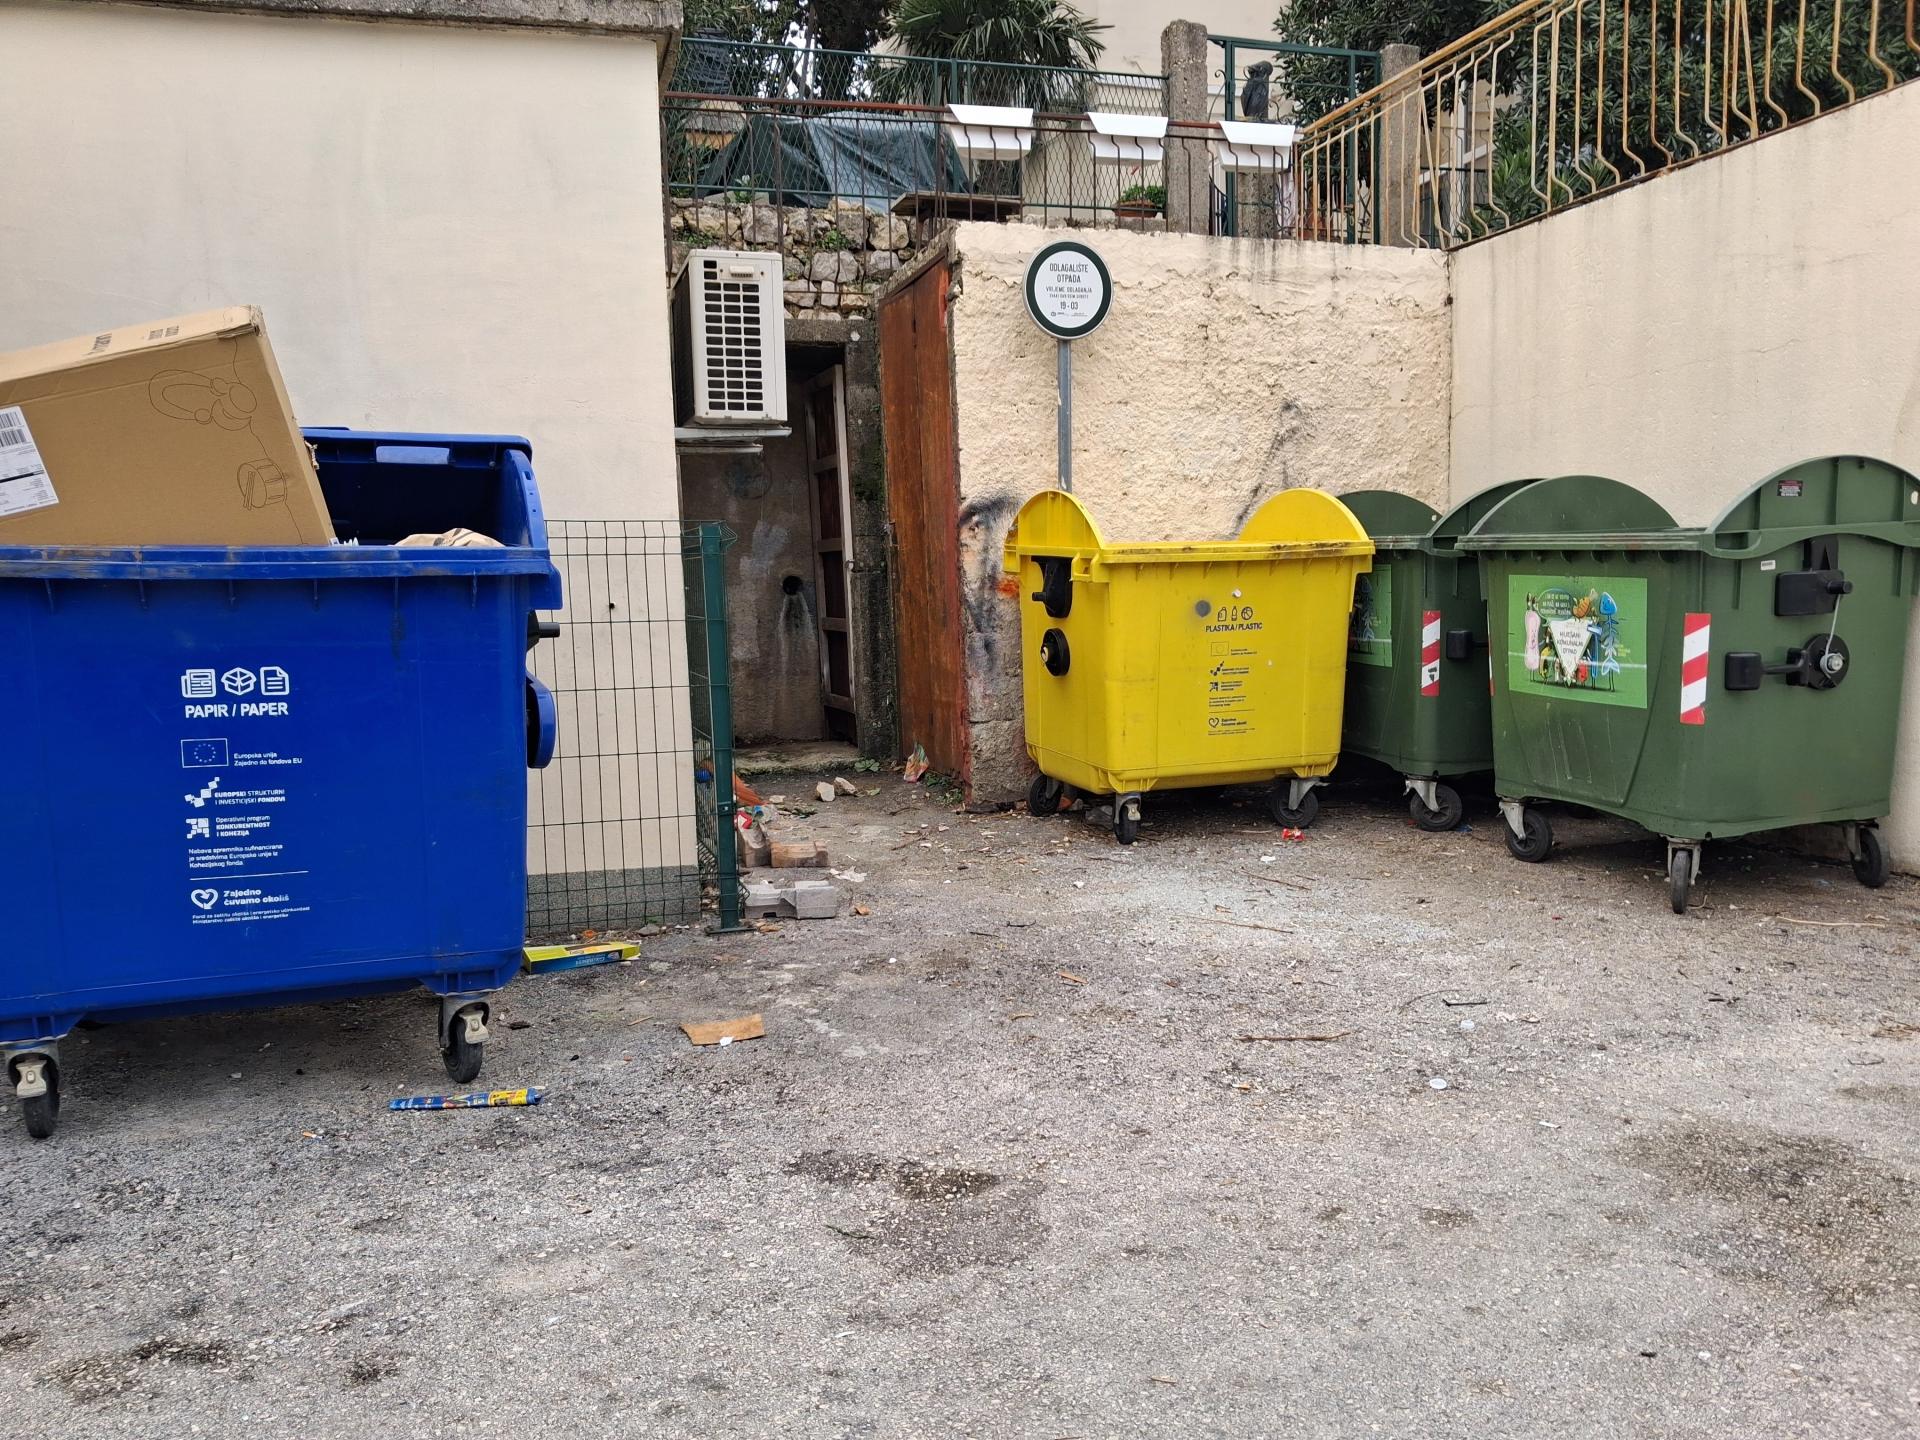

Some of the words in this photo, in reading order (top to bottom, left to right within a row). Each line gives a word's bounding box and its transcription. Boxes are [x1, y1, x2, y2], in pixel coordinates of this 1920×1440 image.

[1049, 263, 1088, 273] ODLAGALIŠTE
[1056, 273, 1081, 283] OTPADA
[1205, 624, 1235, 633] PLASTIKA
[1238, 622, 1263, 631] PLASTIC
[184, 703, 229, 719] PAPIR
[240, 701, 289, 717] PAPER
[233, 752, 262, 760] Europska
[262, 751, 278, 760] unija
[233, 759, 258, 768] Zajedno
[268, 758, 292, 766] fondova
[292, 757, 303, 765] EU
[214, 790, 247, 798] EUROPSKI
[247, 789, 285, 797] STRUKTURNI
[218, 797, 257, 806] INVESTICIJSKI
[257, 796, 286, 804] FONDOVI
[215, 815, 246, 824] Operativni
[246, 815, 271, 823] program
[216, 821, 271, 830] KONKURENTNOST
[220, 829, 250, 837] KOHEZIJA
[212, 846, 244, 855] spremnika
[244, 843, 283, 853] sufinancirana
[195, 854, 228, 862] sredstvima
[229, 852, 257, 861] Europske
[257, 851, 272, 859] unije
[189, 860, 226, 869] Kohezijskog
[223, 888, 262, 899] Zajedno
[223, 896, 261, 907] čuvamo
